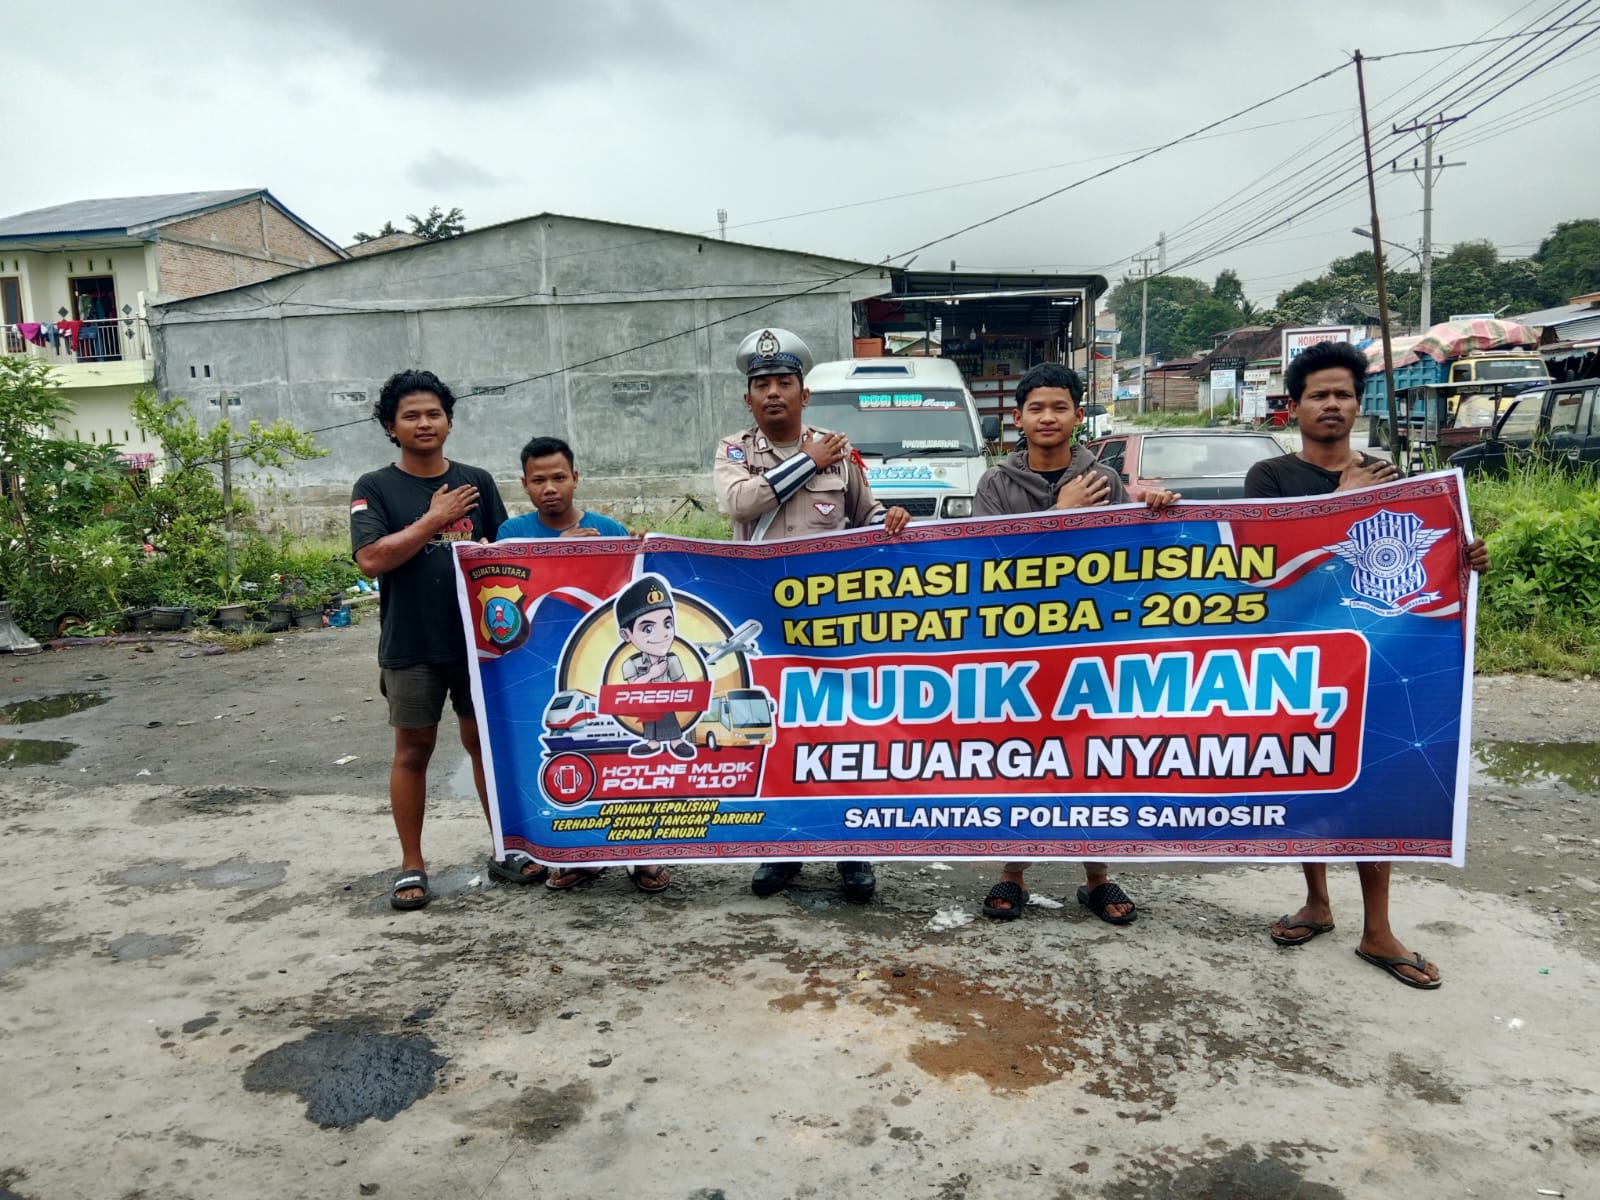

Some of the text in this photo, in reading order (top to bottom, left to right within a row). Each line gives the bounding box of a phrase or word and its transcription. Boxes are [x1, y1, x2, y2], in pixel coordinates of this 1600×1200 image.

[472, 566, 527, 579] SUMATRA UTARA
[773, 546, 1275, 608] OPERASI KEPOLISIAN
[783, 593, 1268, 646] KETUPAT TOBA - 2025
[779, 646, 1348, 728] MUDIK AMAN,
[614, 689, 694, 705] PRESISI
[794, 734, 1334, 782] KELUARGA NYAMAN
[602, 761, 754, 778] HOTLINE MUDIK
[602, 774, 748, 792] POLRI "110"
[600, 800, 719, 816] LAYANAN KEPOLISIAN
[844, 804, 1287, 829] SATLANTAS POLRES SAMOSIR
[552, 812, 765, 831] TERHADAP SITUASI TANGGAP DARURAT
[607, 826, 708, 841] KEPADA PEMUDIK
